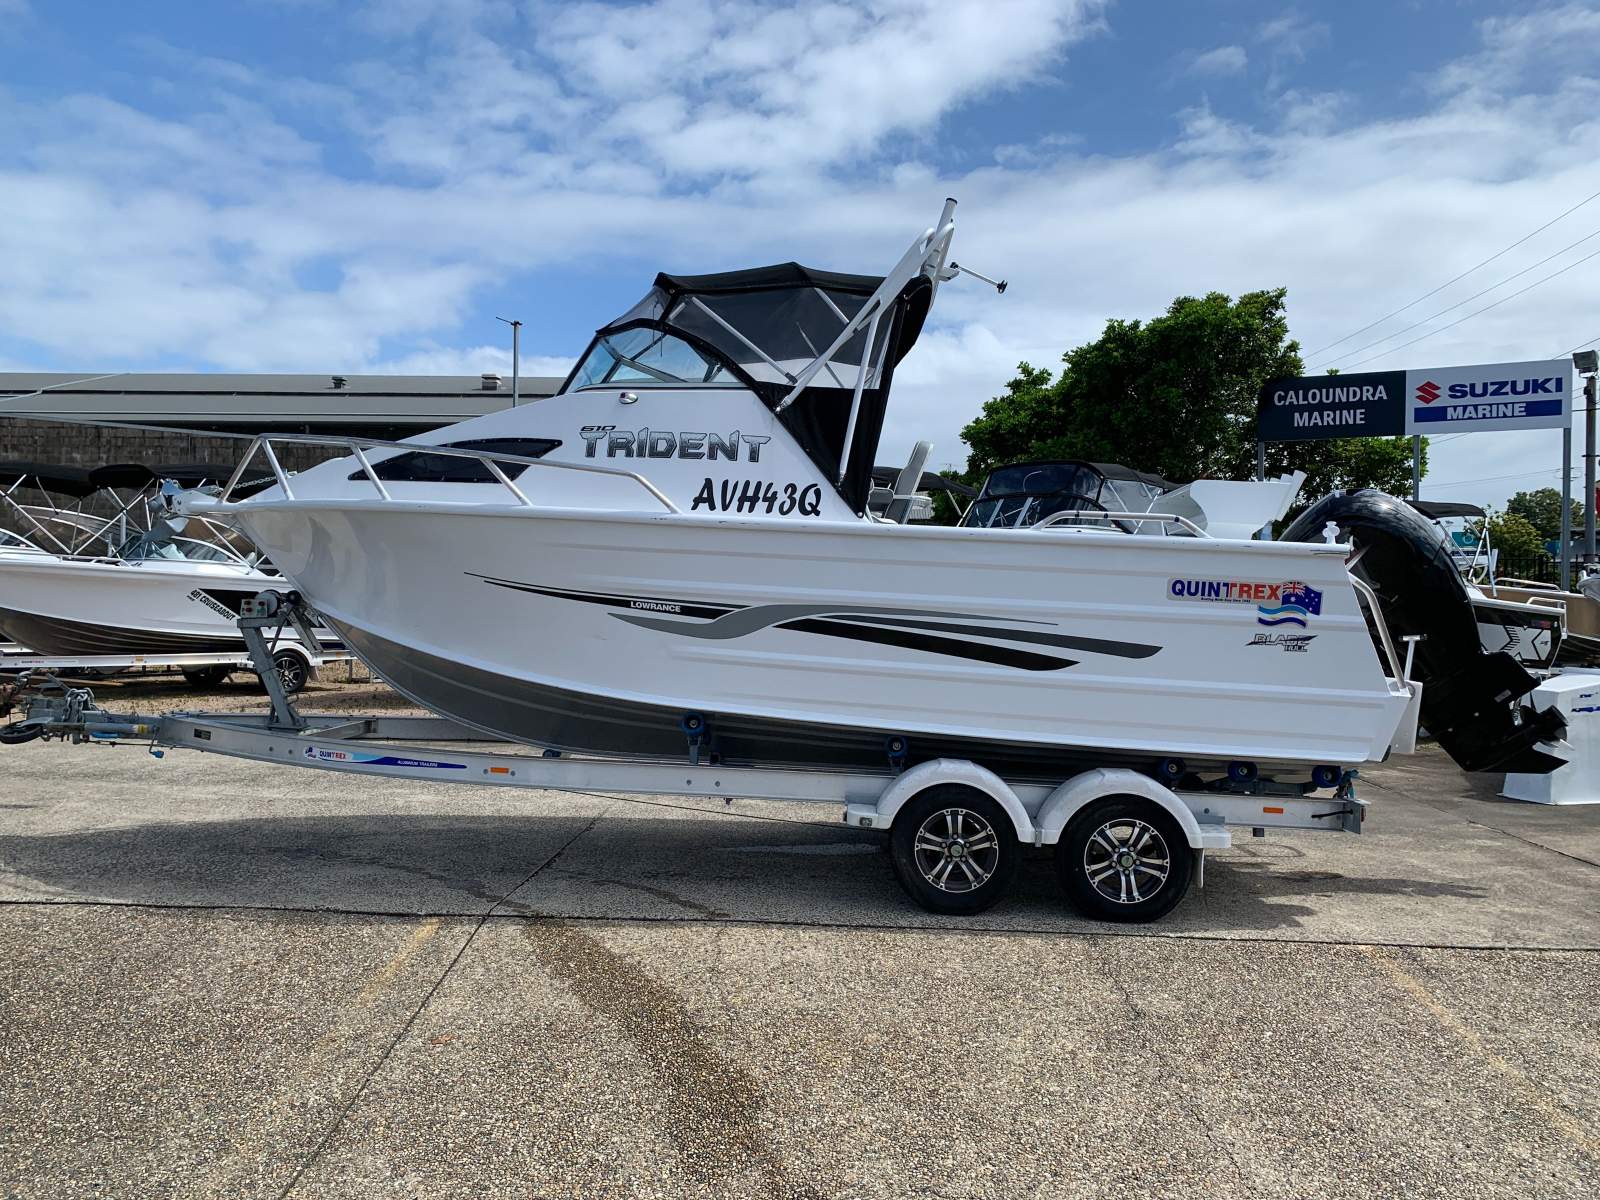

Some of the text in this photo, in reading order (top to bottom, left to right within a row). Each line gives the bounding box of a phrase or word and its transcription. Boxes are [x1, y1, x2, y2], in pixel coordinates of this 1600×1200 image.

[1273, 384, 1388, 406] CALOUNDRA
[1447, 377, 1563, 399] SUZUKI
[1293, 409, 1366, 427] MARINE
[1446, 402, 1527, 421] MARINE
[580, 427, 771, 462] TRIDENT
[690, 477, 822, 517] AVH43Q
[1171, 579, 1281, 601] QUINTREX
[630, 600, 681, 613] LOWRANCE
